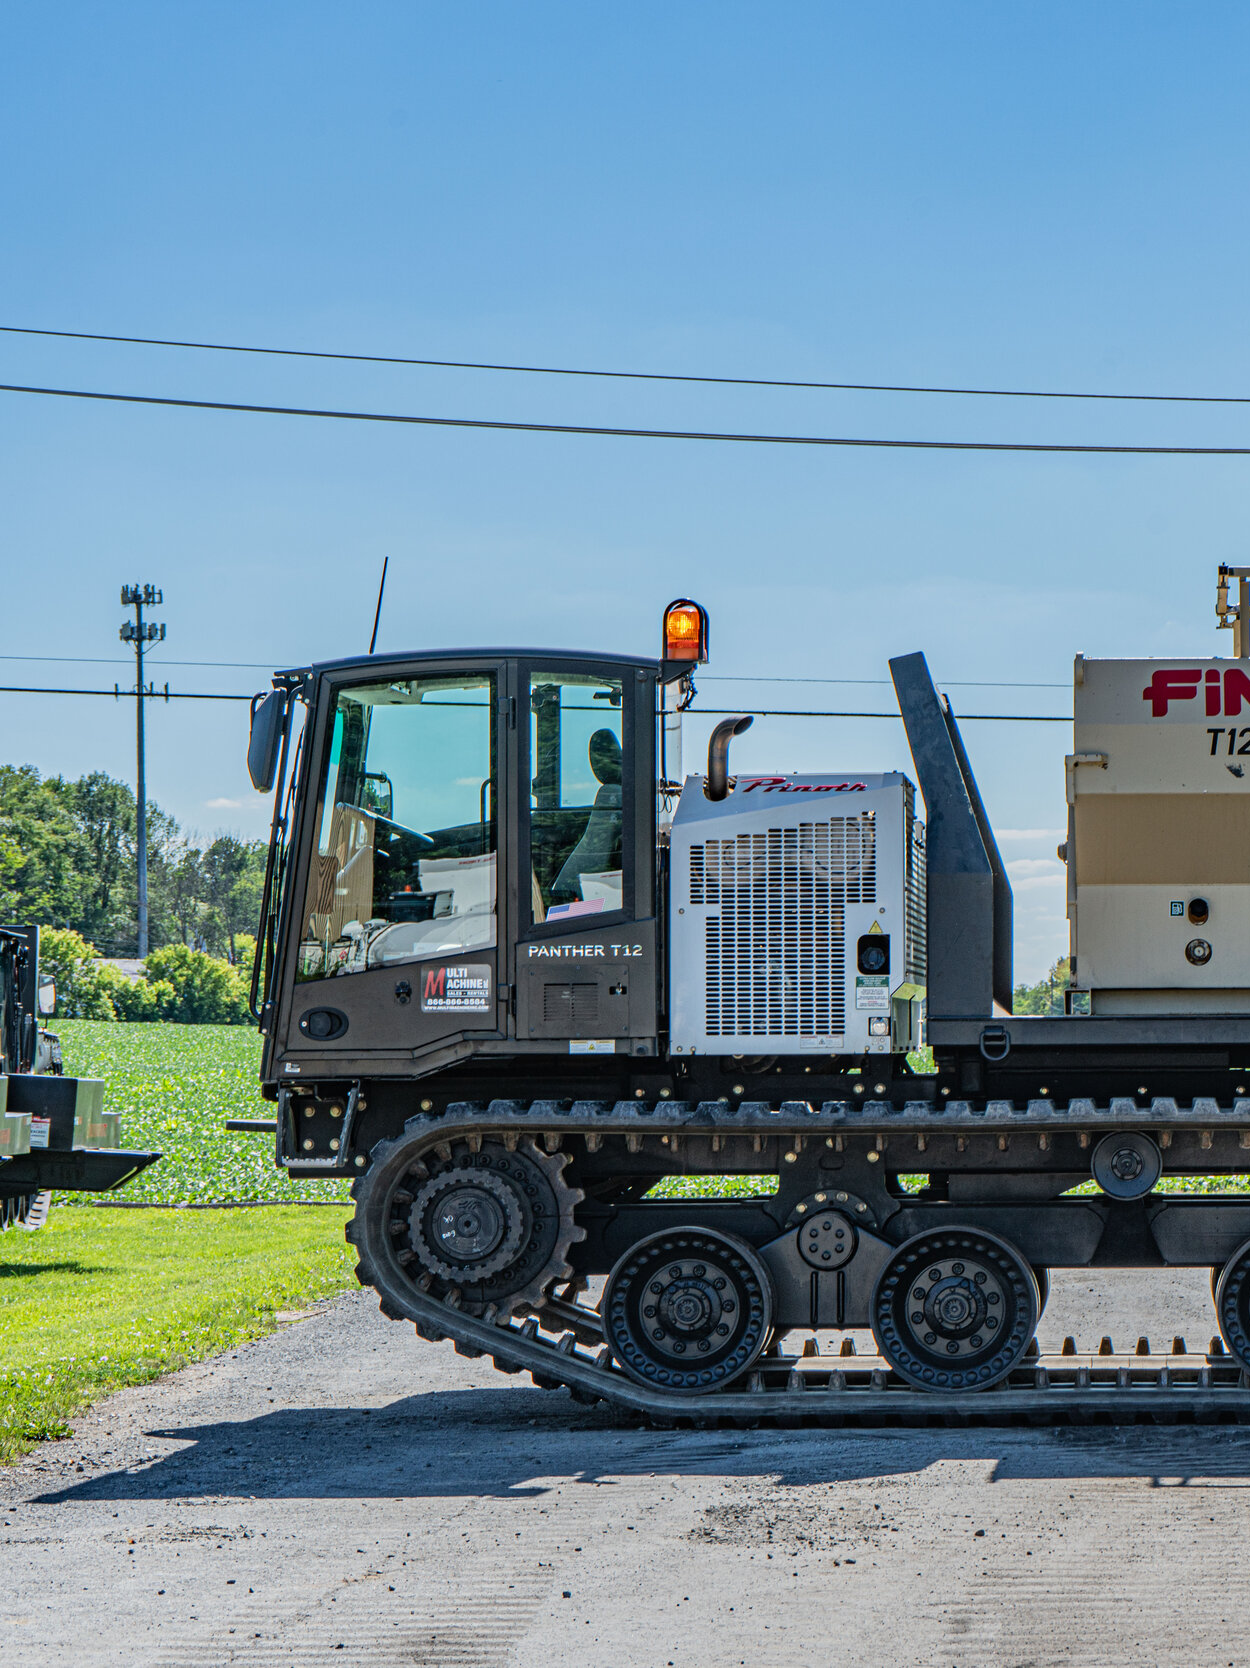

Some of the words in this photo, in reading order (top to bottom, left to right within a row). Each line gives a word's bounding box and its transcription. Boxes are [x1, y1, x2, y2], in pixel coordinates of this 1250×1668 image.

[740, 777, 868, 792] Prinoth
[528, 945, 606, 957] PANTHER
[611, 944, 644, 957] T12
